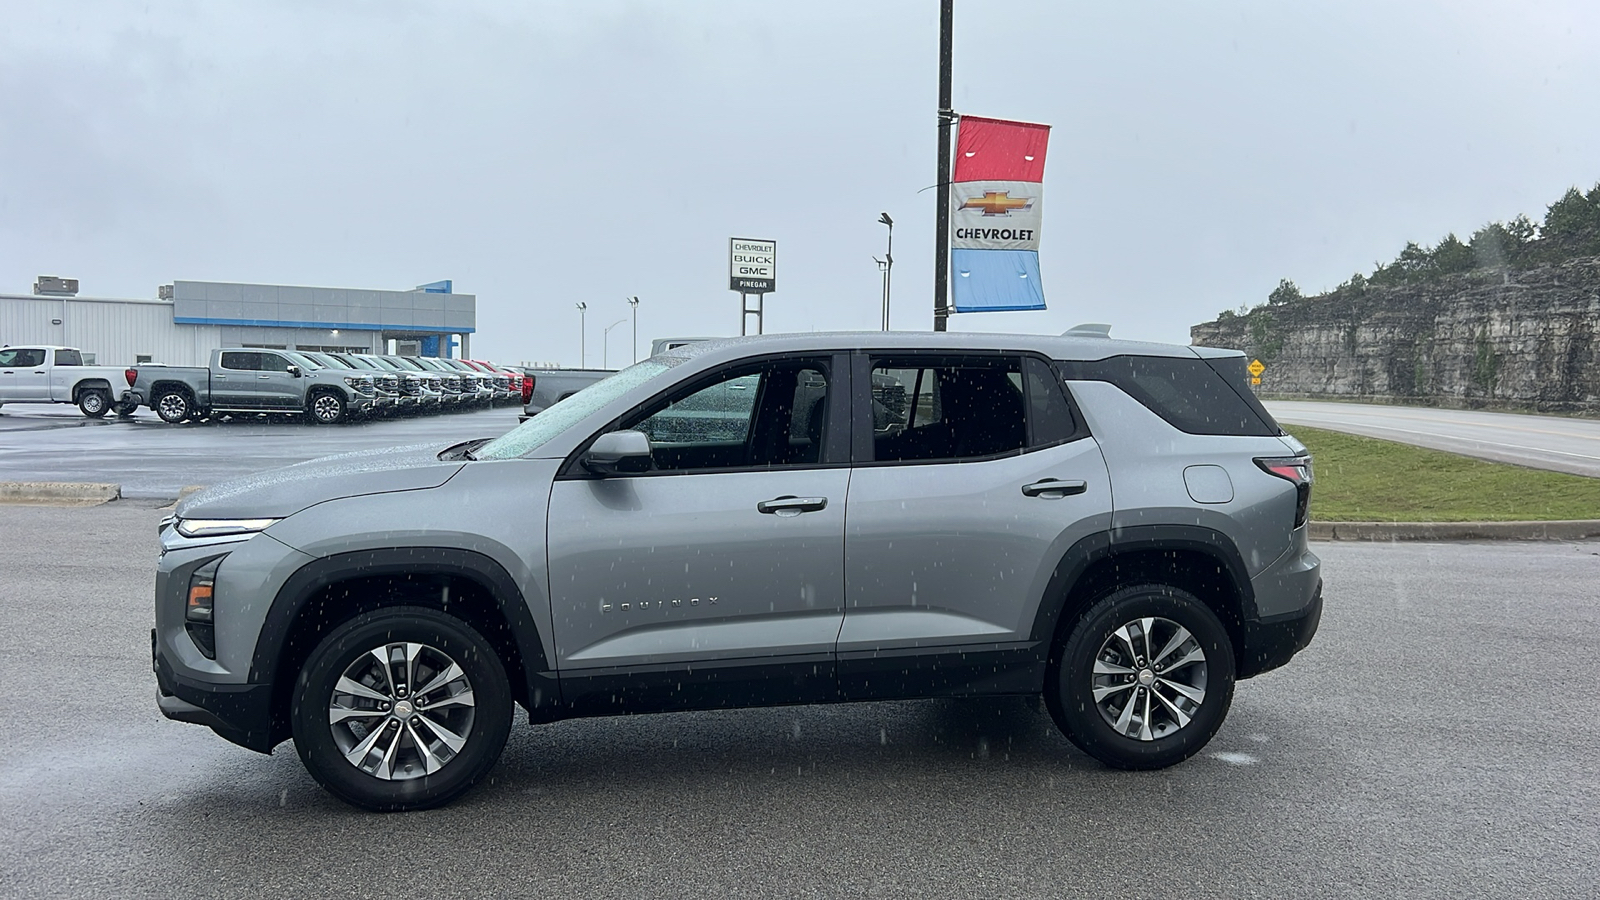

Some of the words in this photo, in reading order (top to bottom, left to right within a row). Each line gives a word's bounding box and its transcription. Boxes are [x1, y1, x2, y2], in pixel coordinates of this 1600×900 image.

[956, 228, 1033, 241] CHEVROLET
[735, 244, 772, 252] CHEVROLET
[734, 255, 772, 264] BUICK
[739, 266, 767, 275] GMC
[739, 280, 767, 288] PINEGAR
[602, 596, 718, 611] EQUINOX
